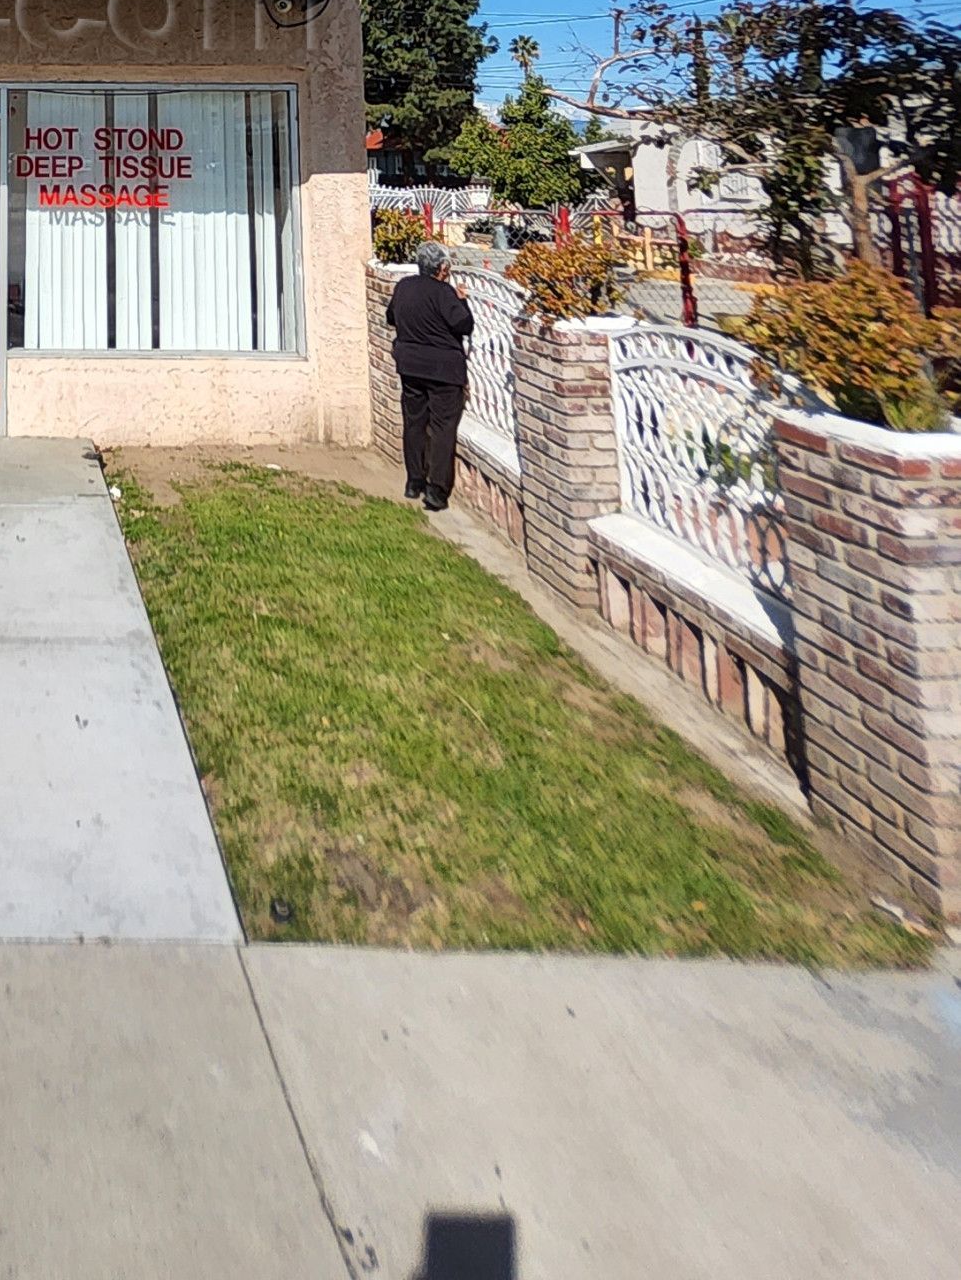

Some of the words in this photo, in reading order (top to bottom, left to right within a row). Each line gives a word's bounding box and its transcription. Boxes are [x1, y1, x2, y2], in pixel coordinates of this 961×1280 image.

[24, 127, 79, 150] HOT
[94, 127, 184, 151] STOND
[16, 155, 84, 178] DEEP
[99, 155, 193, 179] TISSUE
[39, 184, 171, 208] MASSAGE
